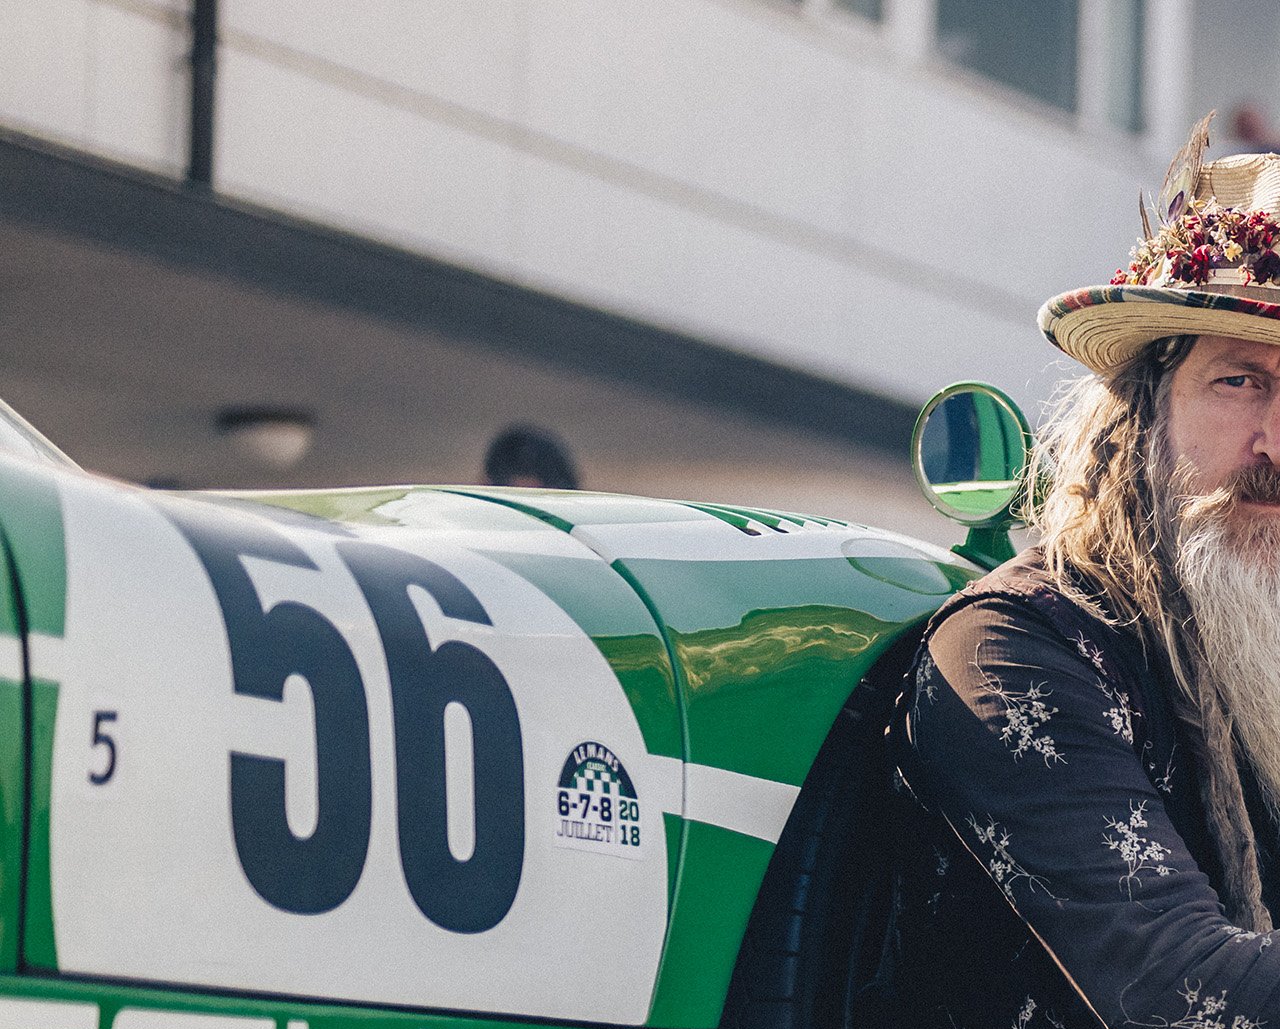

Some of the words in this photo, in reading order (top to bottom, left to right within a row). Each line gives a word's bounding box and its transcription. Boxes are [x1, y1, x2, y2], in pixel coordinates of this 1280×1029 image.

[156, 500, 526, 935] 56
[89, 710, 118, 786] 5
[557, 820, 613, 843] JUILLET
[558, 791, 612, 822] 6-7-8
